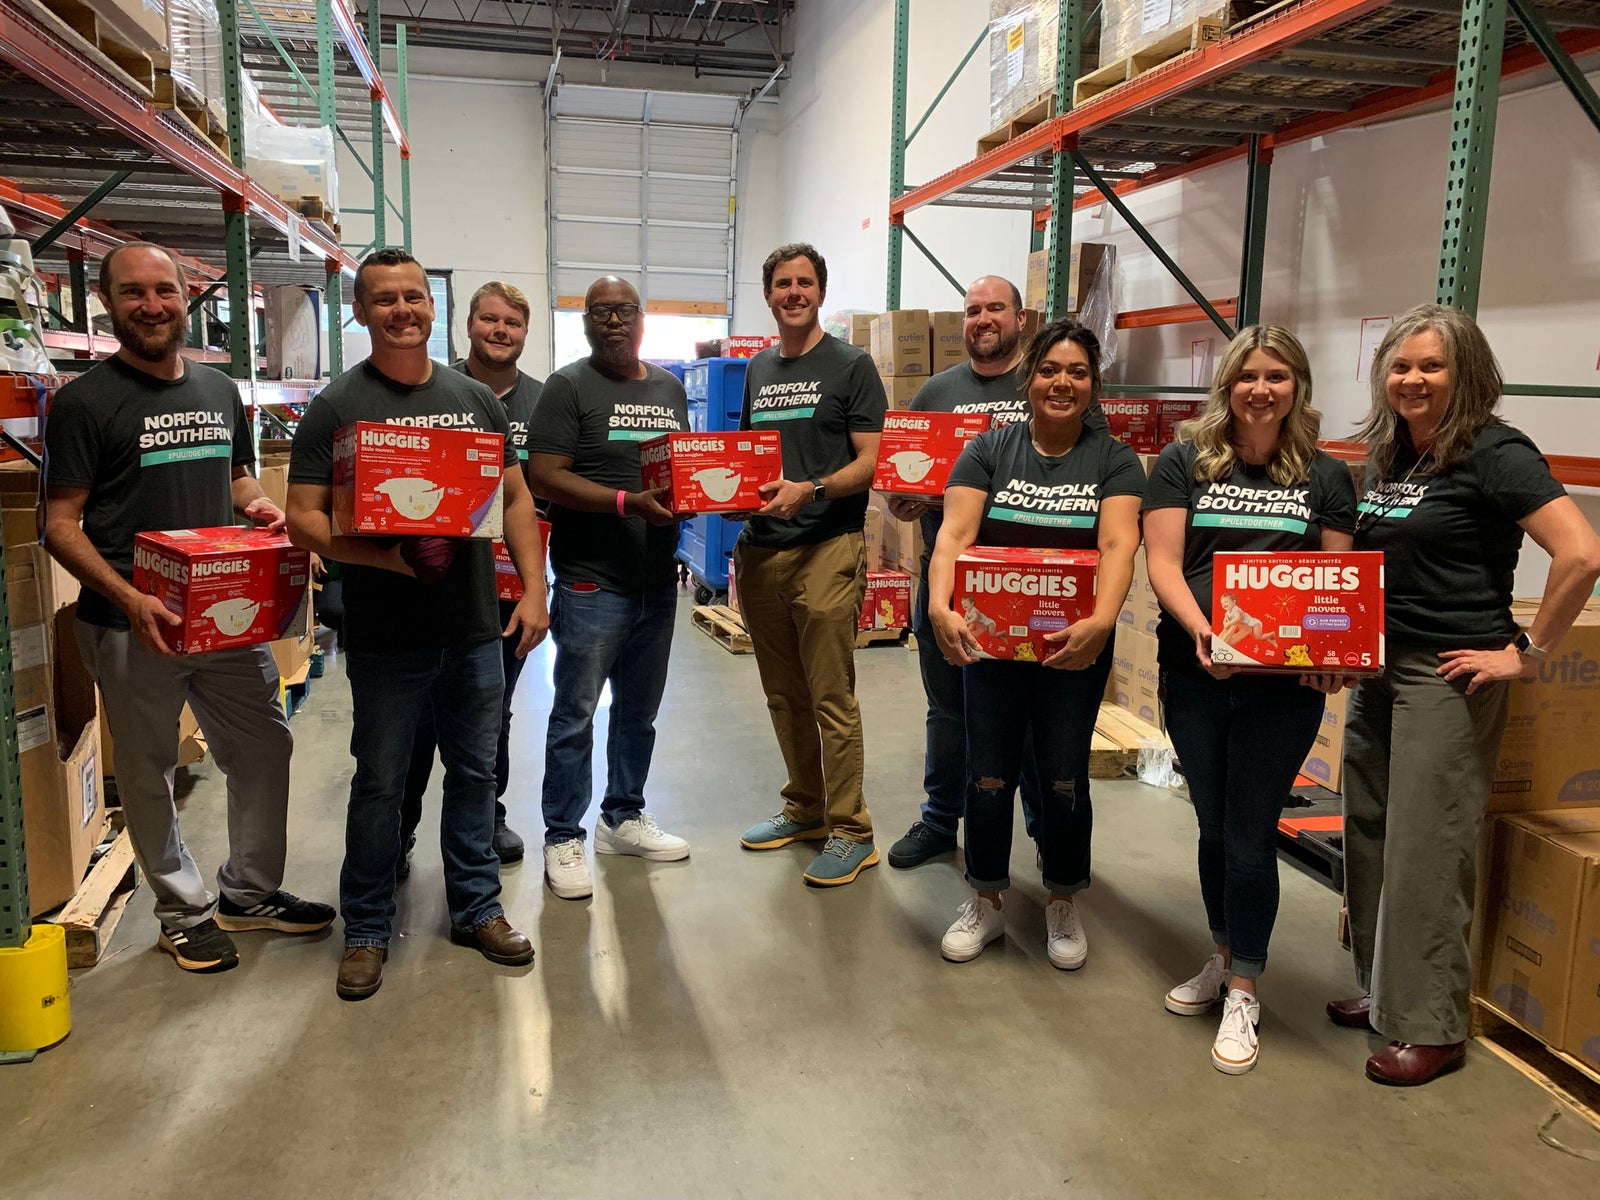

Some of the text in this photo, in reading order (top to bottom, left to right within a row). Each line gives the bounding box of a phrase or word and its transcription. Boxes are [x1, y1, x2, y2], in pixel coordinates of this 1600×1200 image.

[730, 339, 764, 348] HUGGIES
[899, 333, 925, 342] cuties
[941, 333, 964, 342] cutie
[758, 381, 821, 397] NORFOLK
[753, 394, 822, 411] SOUTHERN
[953, 400, 1027, 414] NORFOLK
[1101, 403, 1149, 415] HUGGIES
[1163, 403, 1191, 411] HUGGIES
[614, 403, 675, 418] NORFOLK
[144, 411, 224, 430] NORFOLK
[608, 416, 681, 430] SOUTHERN
[883, 418, 930, 430] HUGGIES
[139, 427, 231, 449] SOUTHERN
[361, 430, 430, 450] HUGGIES
[673, 440, 725, 453] HUGGIES
[640, 443, 671, 467] HUGGIES
[1007, 479, 1098, 498] NORFOLK
[1208, 482, 1309, 503] NORFOLK
[994, 490, 1100, 512] SOUTHERN
[1364, 490, 1424, 506] SOUHERN
[1196, 495, 1311, 519] SOUTHERN
[380, 517, 387, 525] 5
[1013, 513, 1072, 525] #PULLTOGETHER
[1220, 517, 1284, 528] #PULLTOGETHER
[134, 545, 189, 585] HUGGIES
[192, 560, 250, 577] HUGGIES
[876, 580, 911, 588] HUGGIES
[965, 570, 1077, 597] HUGGIES
[1226, 564, 1360, 591] HUGGIES
[1039, 600, 1060, 609] little
[1314, 595, 1339, 604] little
[1307, 605, 1346, 613] movers
[1213, 652, 1233, 661] 100
[1361, 653, 1372, 666] 5
[1520, 651, 1600, 684] utie
